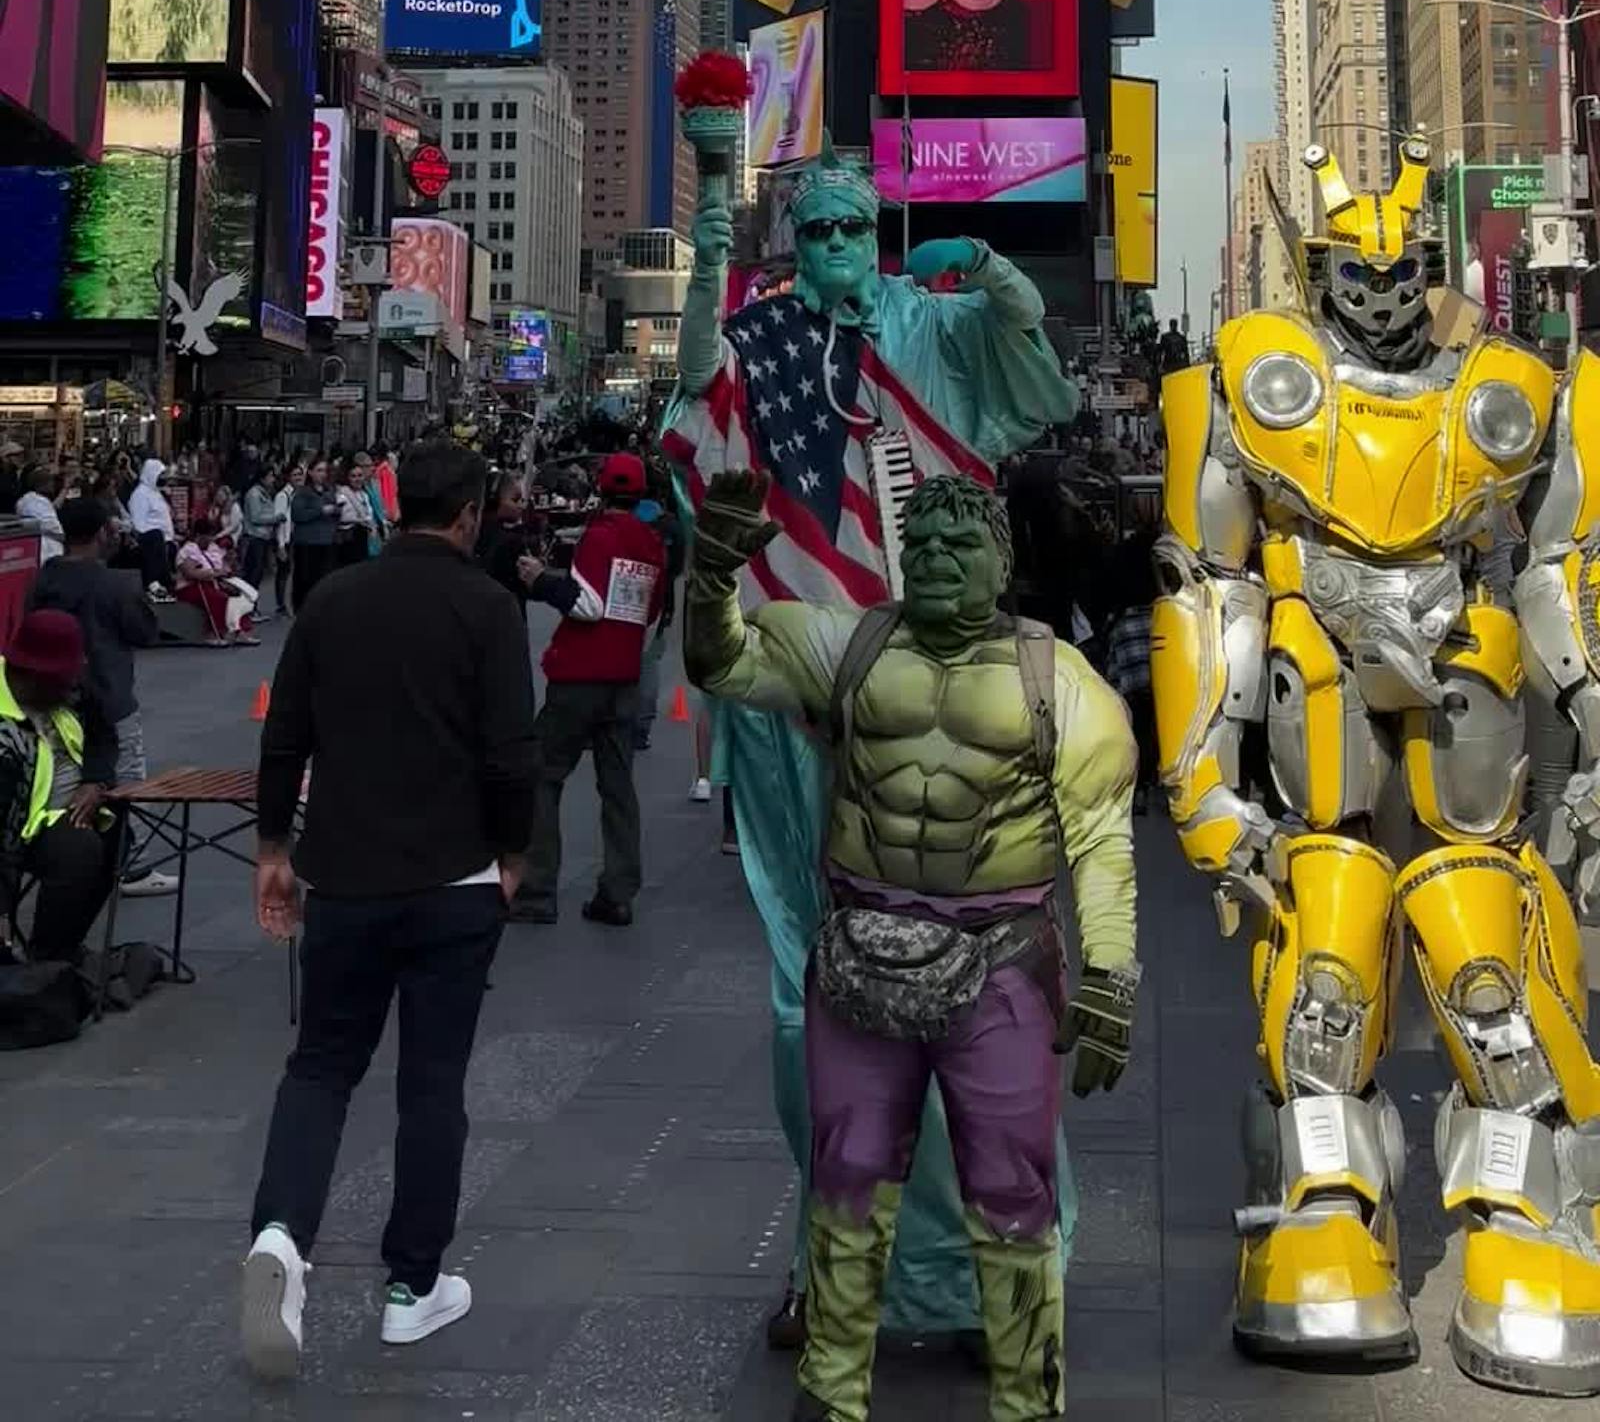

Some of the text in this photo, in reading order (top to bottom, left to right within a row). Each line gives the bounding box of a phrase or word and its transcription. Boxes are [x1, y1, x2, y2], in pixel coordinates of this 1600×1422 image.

[910, 141, 1056, 167] NINE WEST
[306, 121, 332, 302] CHICAGO
